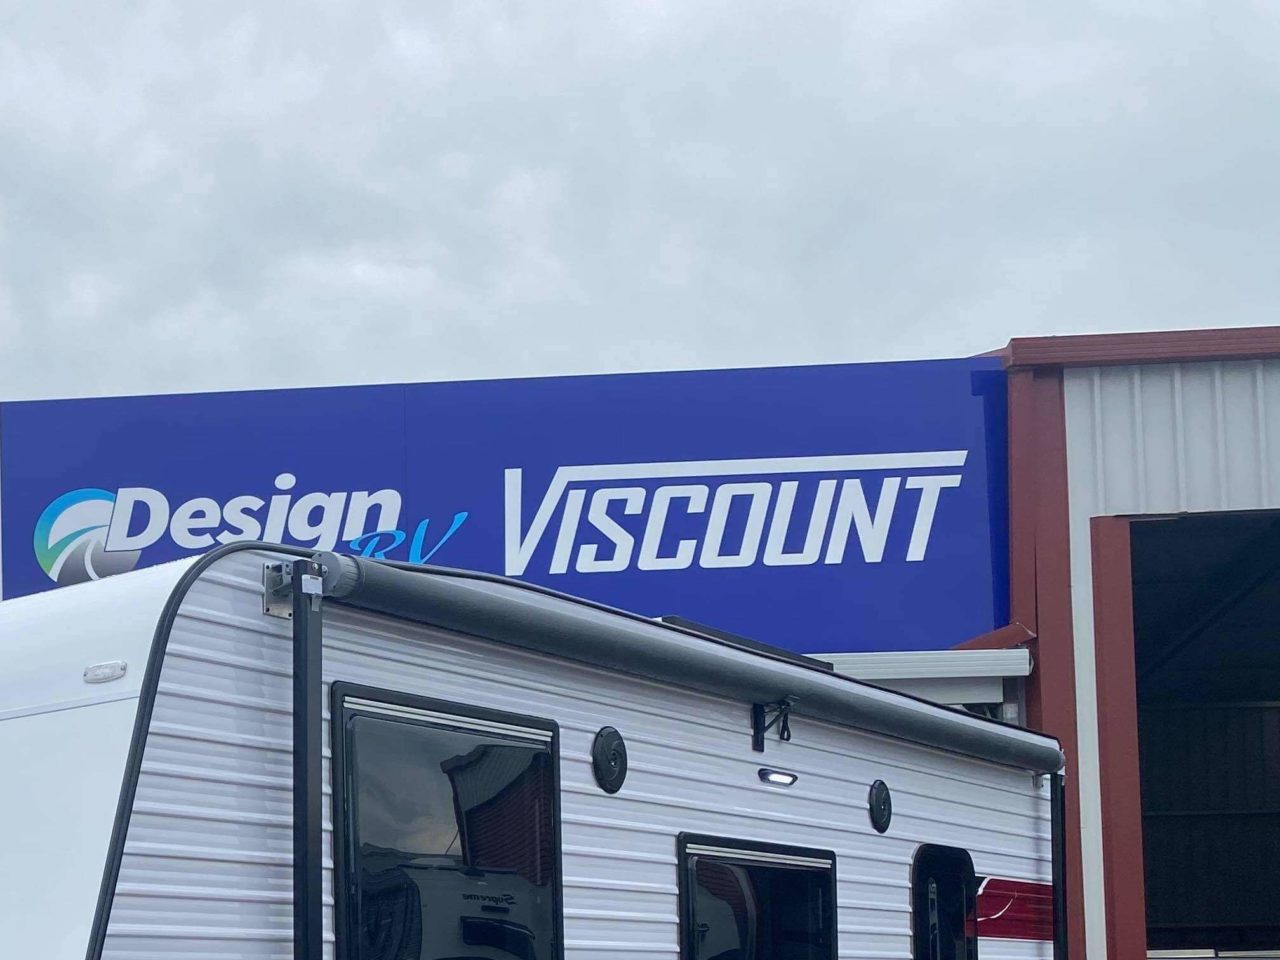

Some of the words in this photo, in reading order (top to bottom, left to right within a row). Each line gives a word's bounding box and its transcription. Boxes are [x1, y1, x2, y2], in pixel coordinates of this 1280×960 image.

[104, 473, 402, 552] Design
[350, 511, 469, 565] RV
[504, 450, 968, 576] VISCOUNT
